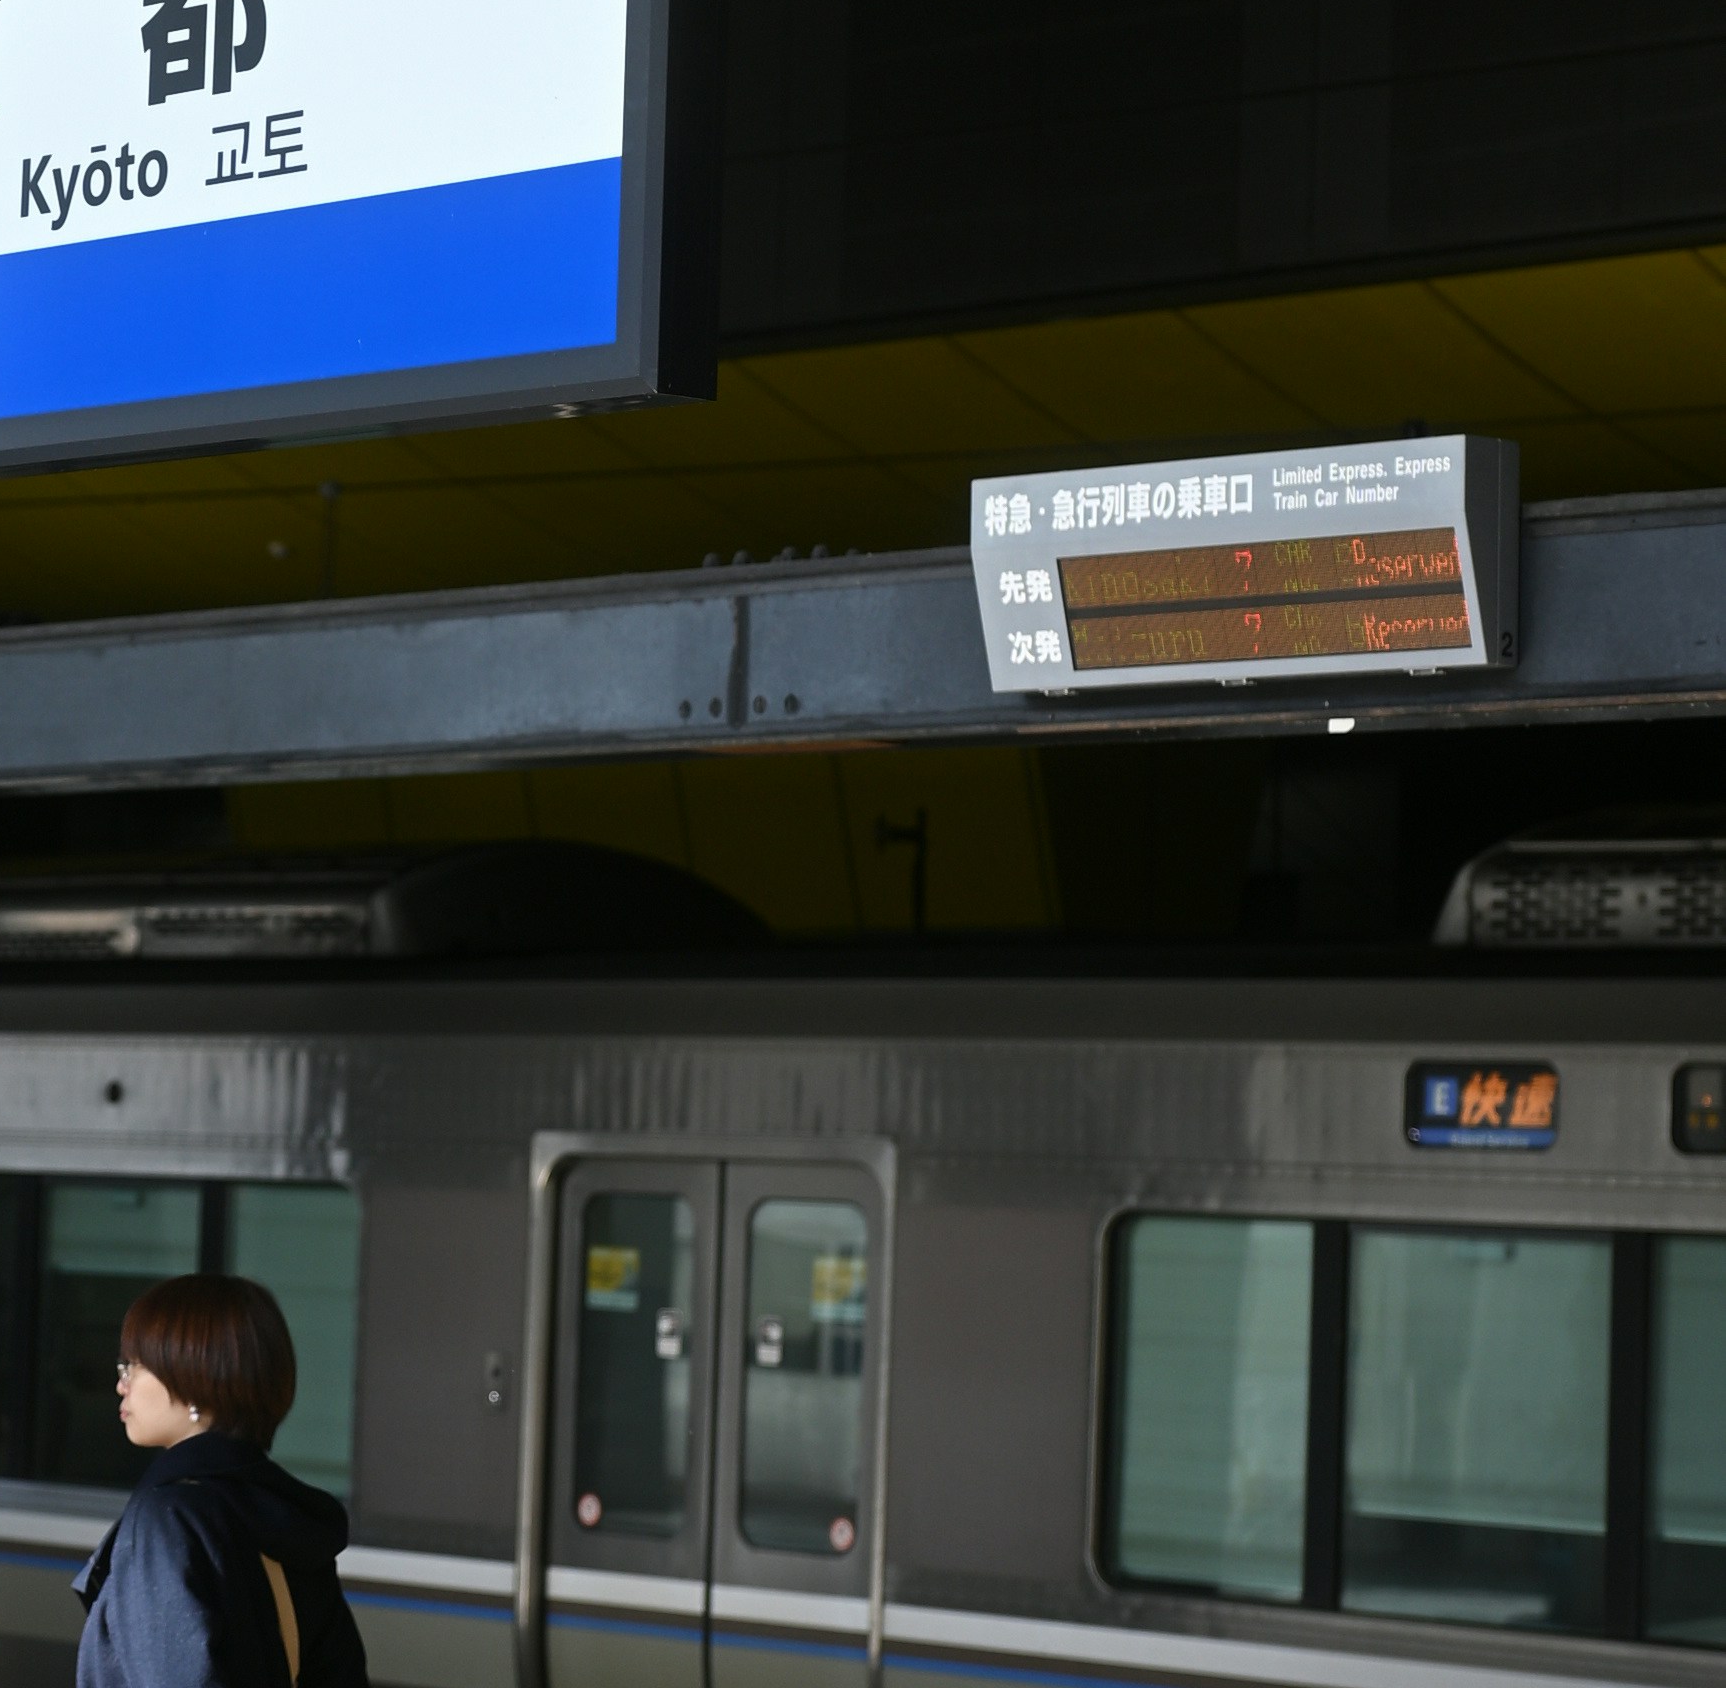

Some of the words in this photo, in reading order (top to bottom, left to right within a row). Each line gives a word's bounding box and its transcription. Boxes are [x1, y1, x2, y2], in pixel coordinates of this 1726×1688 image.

[20, 141, 170, 232] Kyōto
[204, 109, 309, 187] 교토
[1272, 464, 1322, 487] Limited
[1394, 456, 1451, 479] Express
[984, 473, 1254, 537] 特急・急行列車の乗車口
[1272, 490, 1308, 511] Train
[1314, 488, 1339, 508] Car
[1345, 483, 1400, 505] Number
[999, 569, 1053, 605] 先発
[1007, 629, 1062, 664] 次発
[1501, 631, 1514, 657] 2
